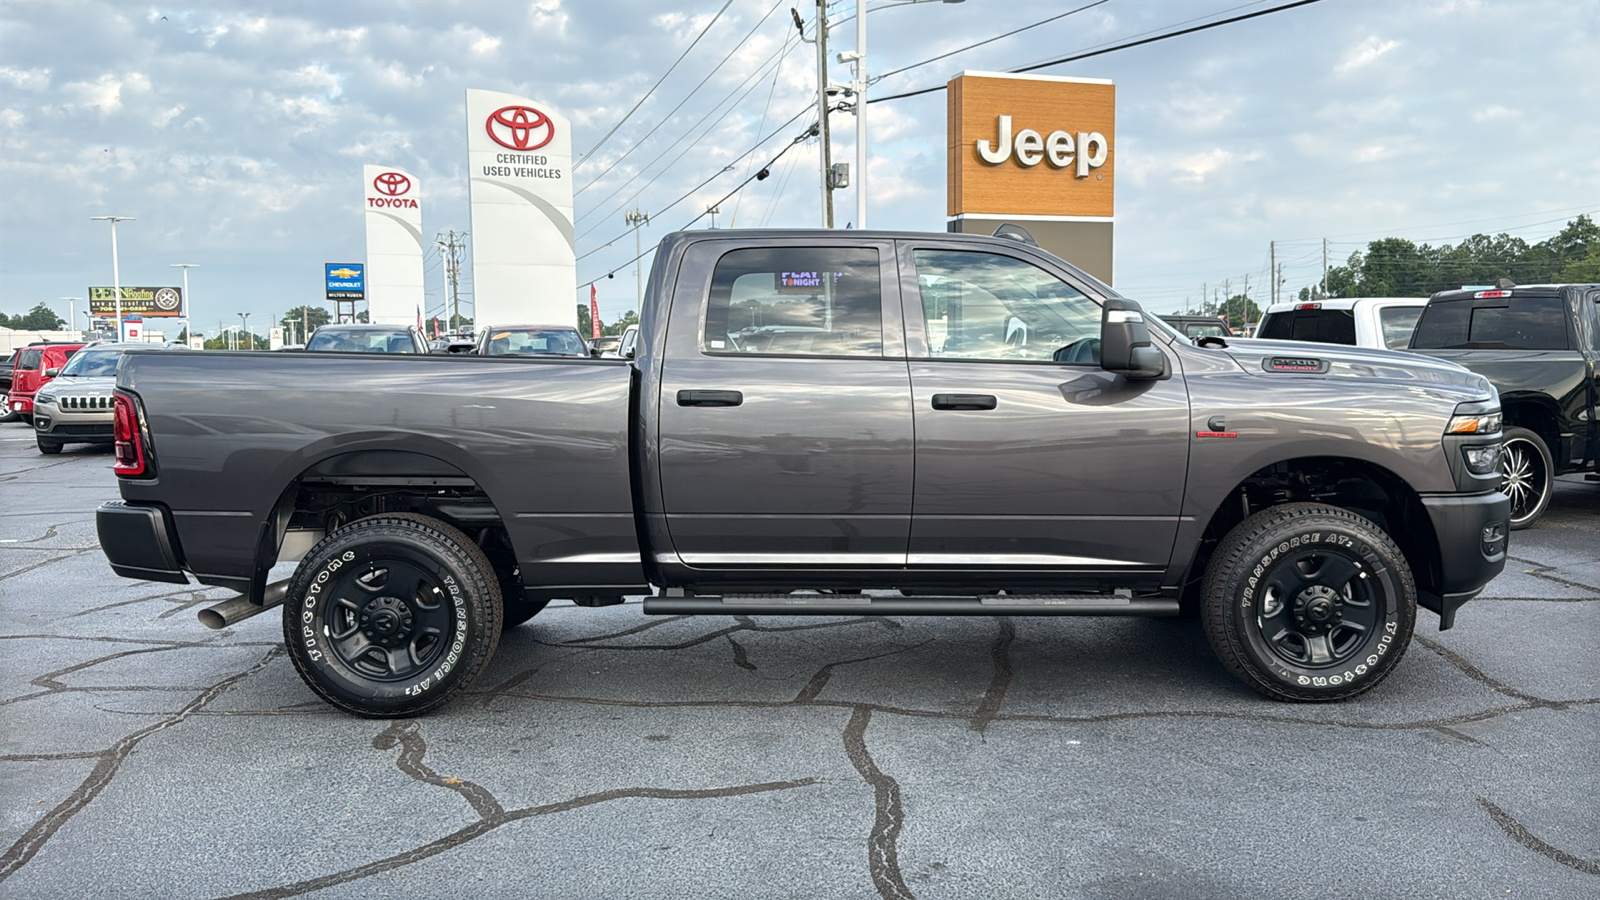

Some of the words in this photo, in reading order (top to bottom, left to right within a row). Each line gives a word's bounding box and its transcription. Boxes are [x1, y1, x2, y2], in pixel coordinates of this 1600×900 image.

[483, 166, 511, 177] USED
[514, 167, 561, 179] VEHICLES
[496, 154, 547, 165] CERTIFIED
[976, 115, 1108, 178] Jeep
[367, 197, 418, 209] TOYOTA
[129, 289, 154, 300] Roofing
[1241, 533, 1320, 608] TRANSFORCE
[302, 550, 355, 662] Firestone
[434, 575, 467, 681] TRANSFORCE
[1297, 621, 1397, 686] Firestone
